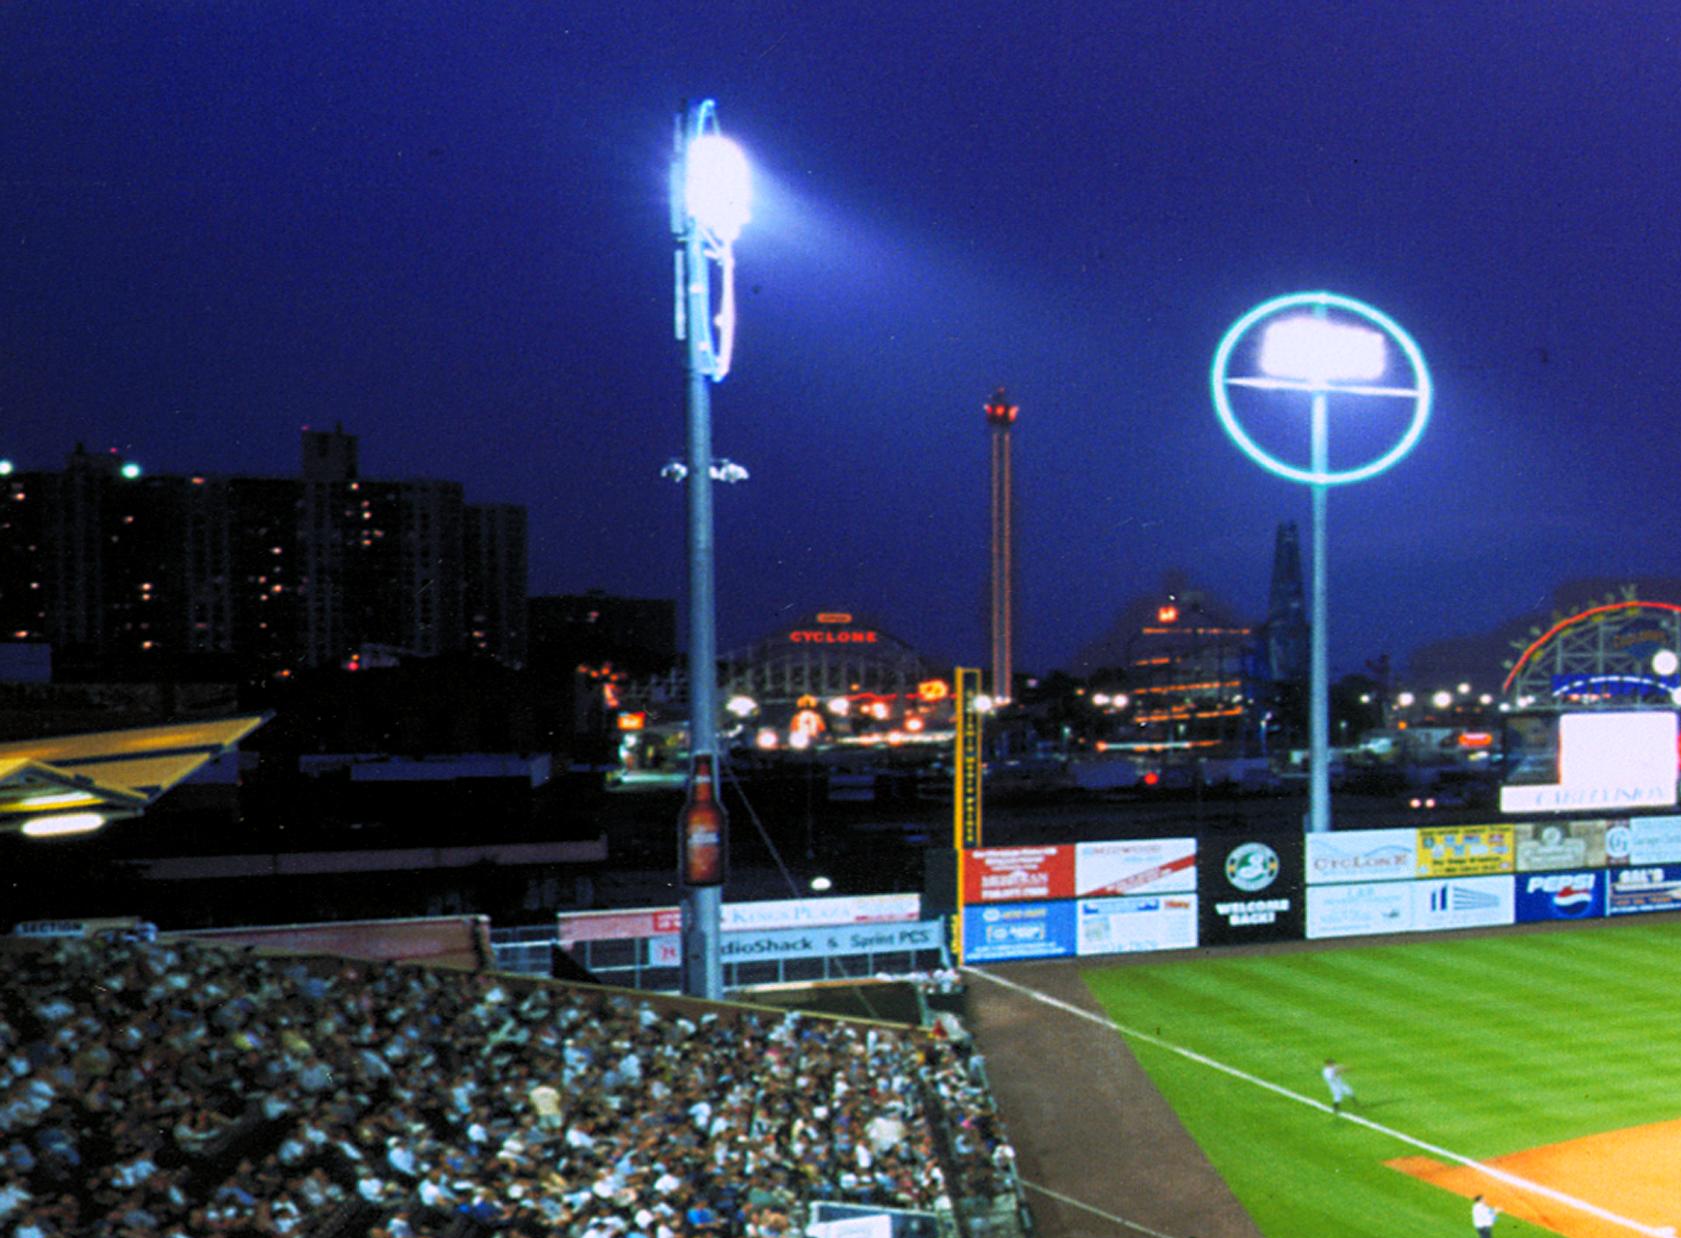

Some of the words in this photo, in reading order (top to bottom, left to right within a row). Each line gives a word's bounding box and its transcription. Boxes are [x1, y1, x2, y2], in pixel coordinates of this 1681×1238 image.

[790, 631, 876, 642] CYCLONE
[1527, 873, 1595, 893] PEPSI
[1215, 899, 1290, 915] WELCOME
[1229, 911, 1275, 926] BACK!
[899, 924, 930, 942] PCS
